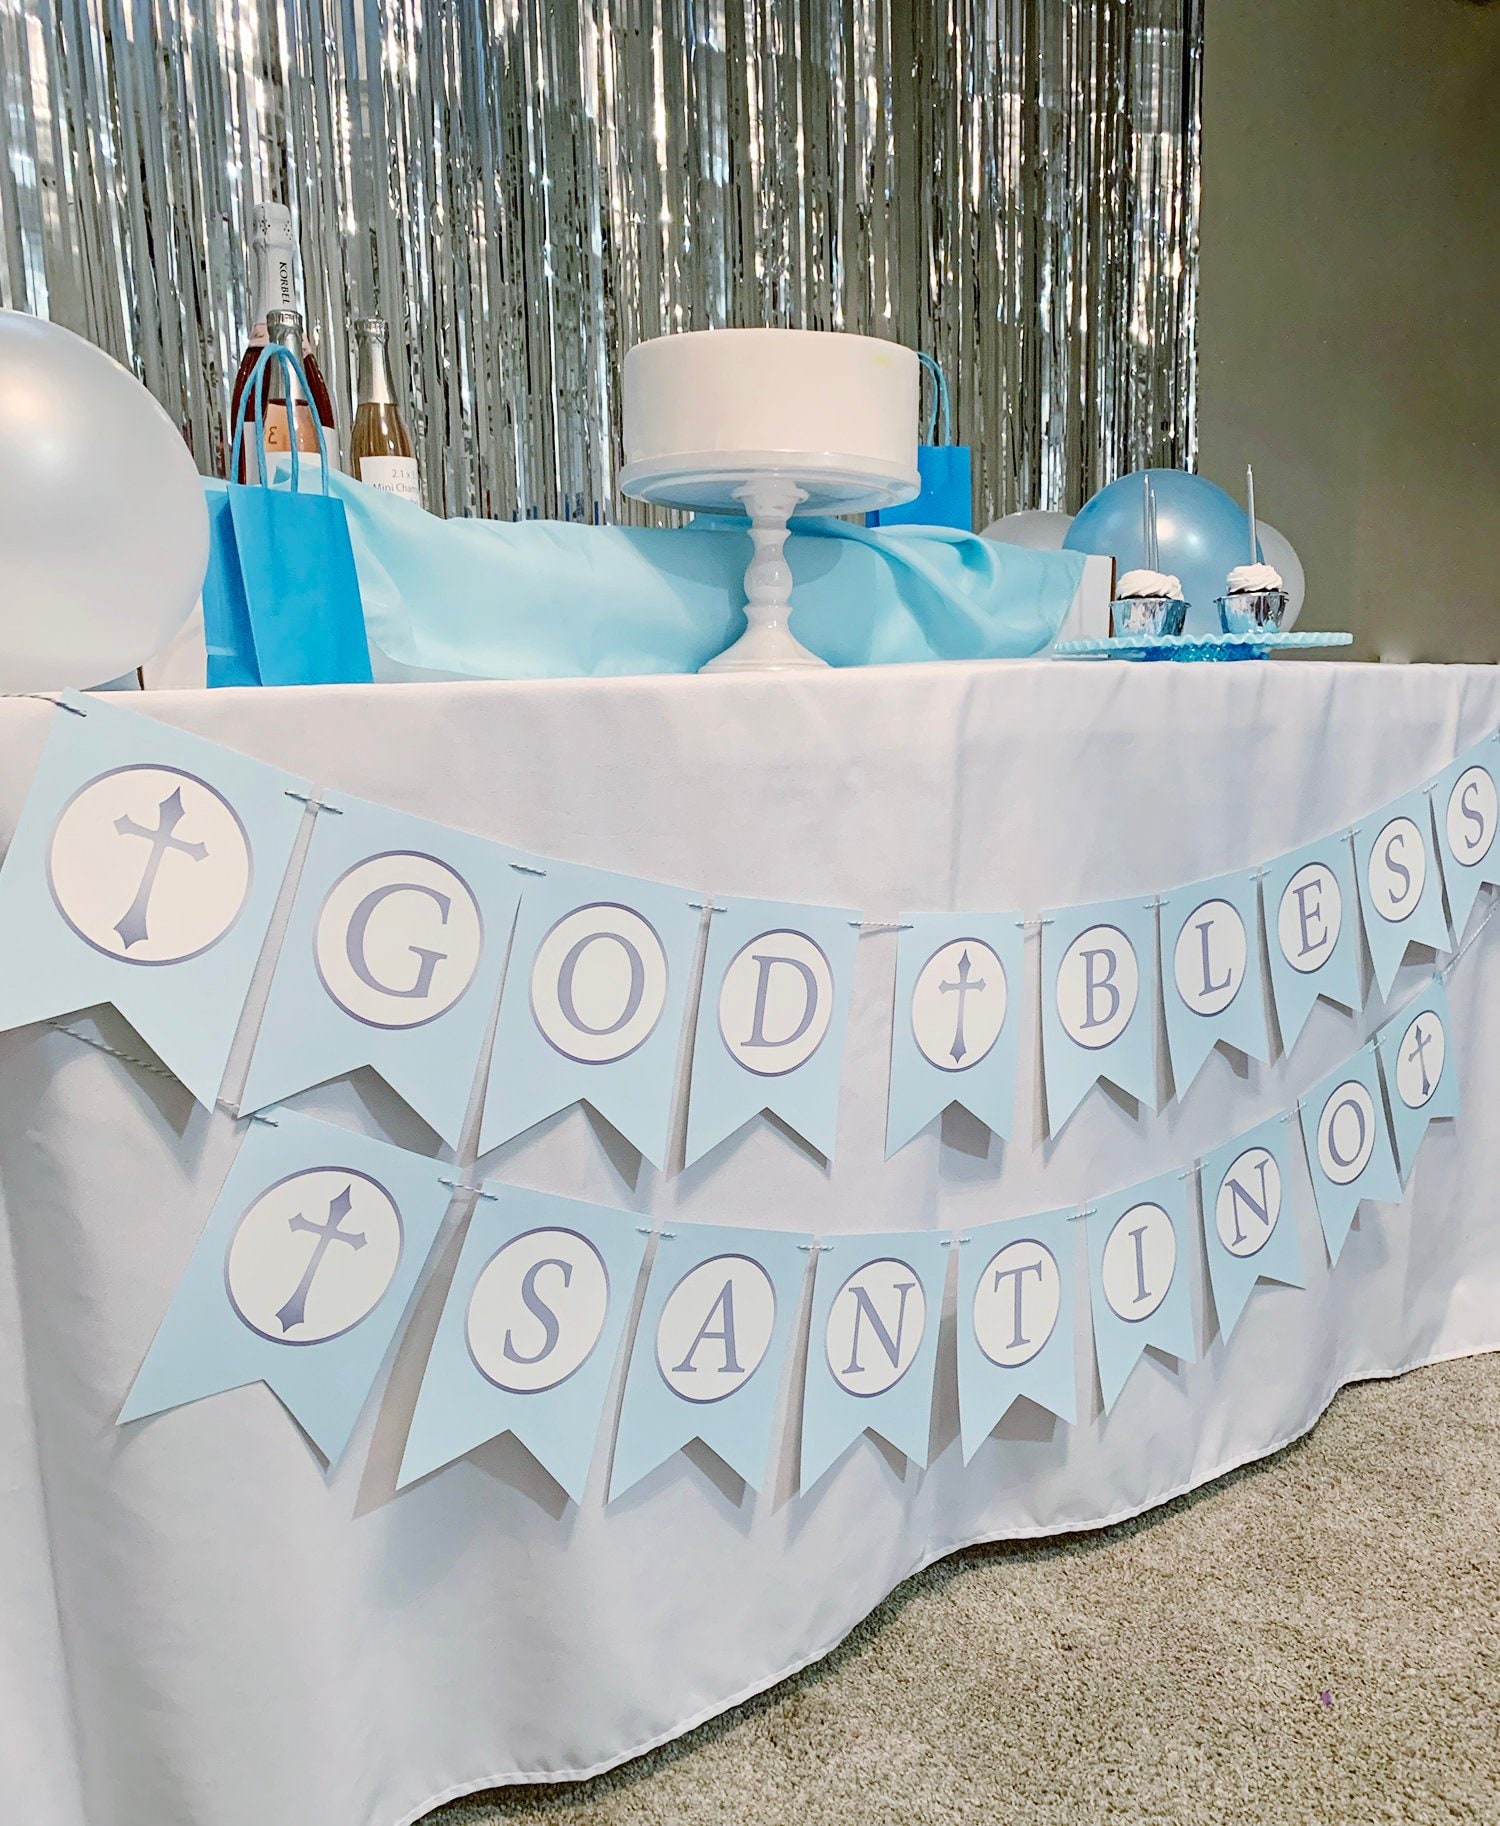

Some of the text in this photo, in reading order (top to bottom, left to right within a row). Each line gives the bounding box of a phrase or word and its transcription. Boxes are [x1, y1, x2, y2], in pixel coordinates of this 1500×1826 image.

[279, 261, 290, 304] KORBEL
[372, 482, 394, 492] Mini
[345, 782, 1485, 1048] GOD BLESS
[503, 1091, 1368, 1374] SANTINO
